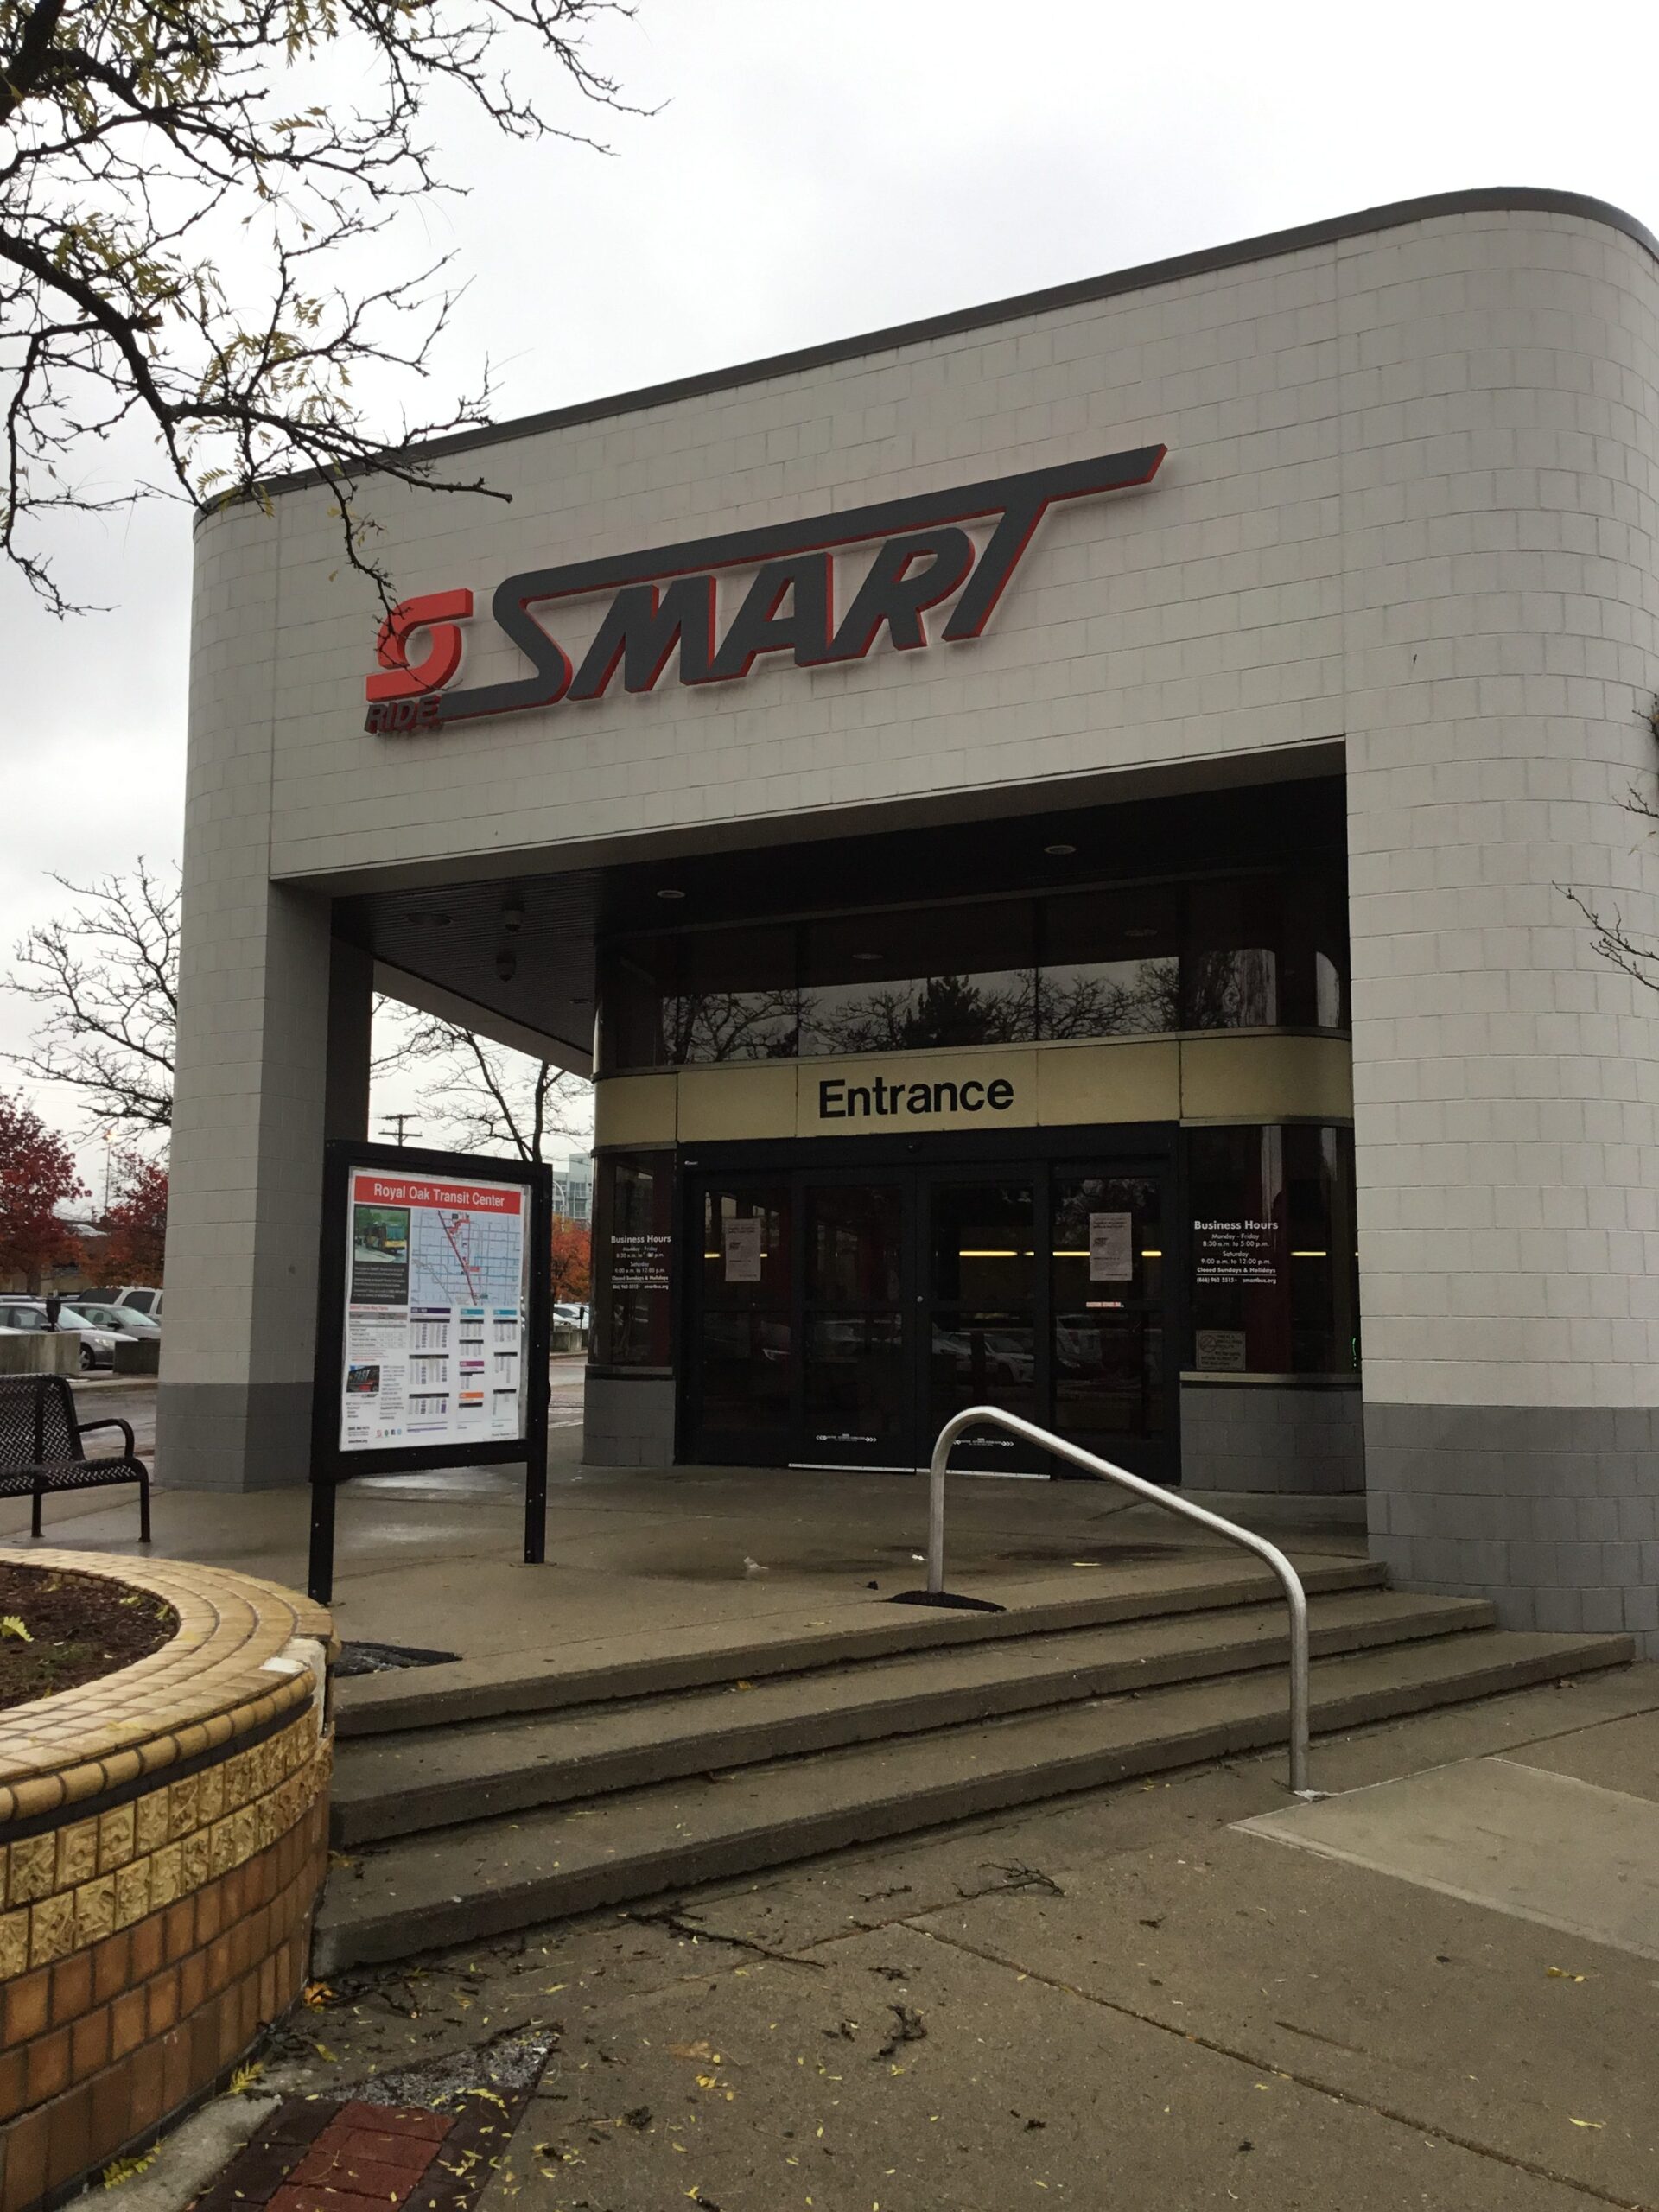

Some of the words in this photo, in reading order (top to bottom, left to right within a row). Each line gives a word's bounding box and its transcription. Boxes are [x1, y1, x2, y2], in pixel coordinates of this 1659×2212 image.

[438, 443, 1168, 723] SMART
[364, 694, 442, 734] RIDE
[819, 1076, 1014, 1119] Entrance
[373, 1183, 406, 1200] Royal
[409, 1186, 430, 1201] Oak
[433, 1188, 469, 1205] Transit
[472, 1192, 505, 1207] Center
[611, 1235, 645, 1243] Business
[646, 1234, 671, 1243] Hours
[1194, 1220, 1242, 1230] Business
[1244, 1220, 1279, 1230] Hours
